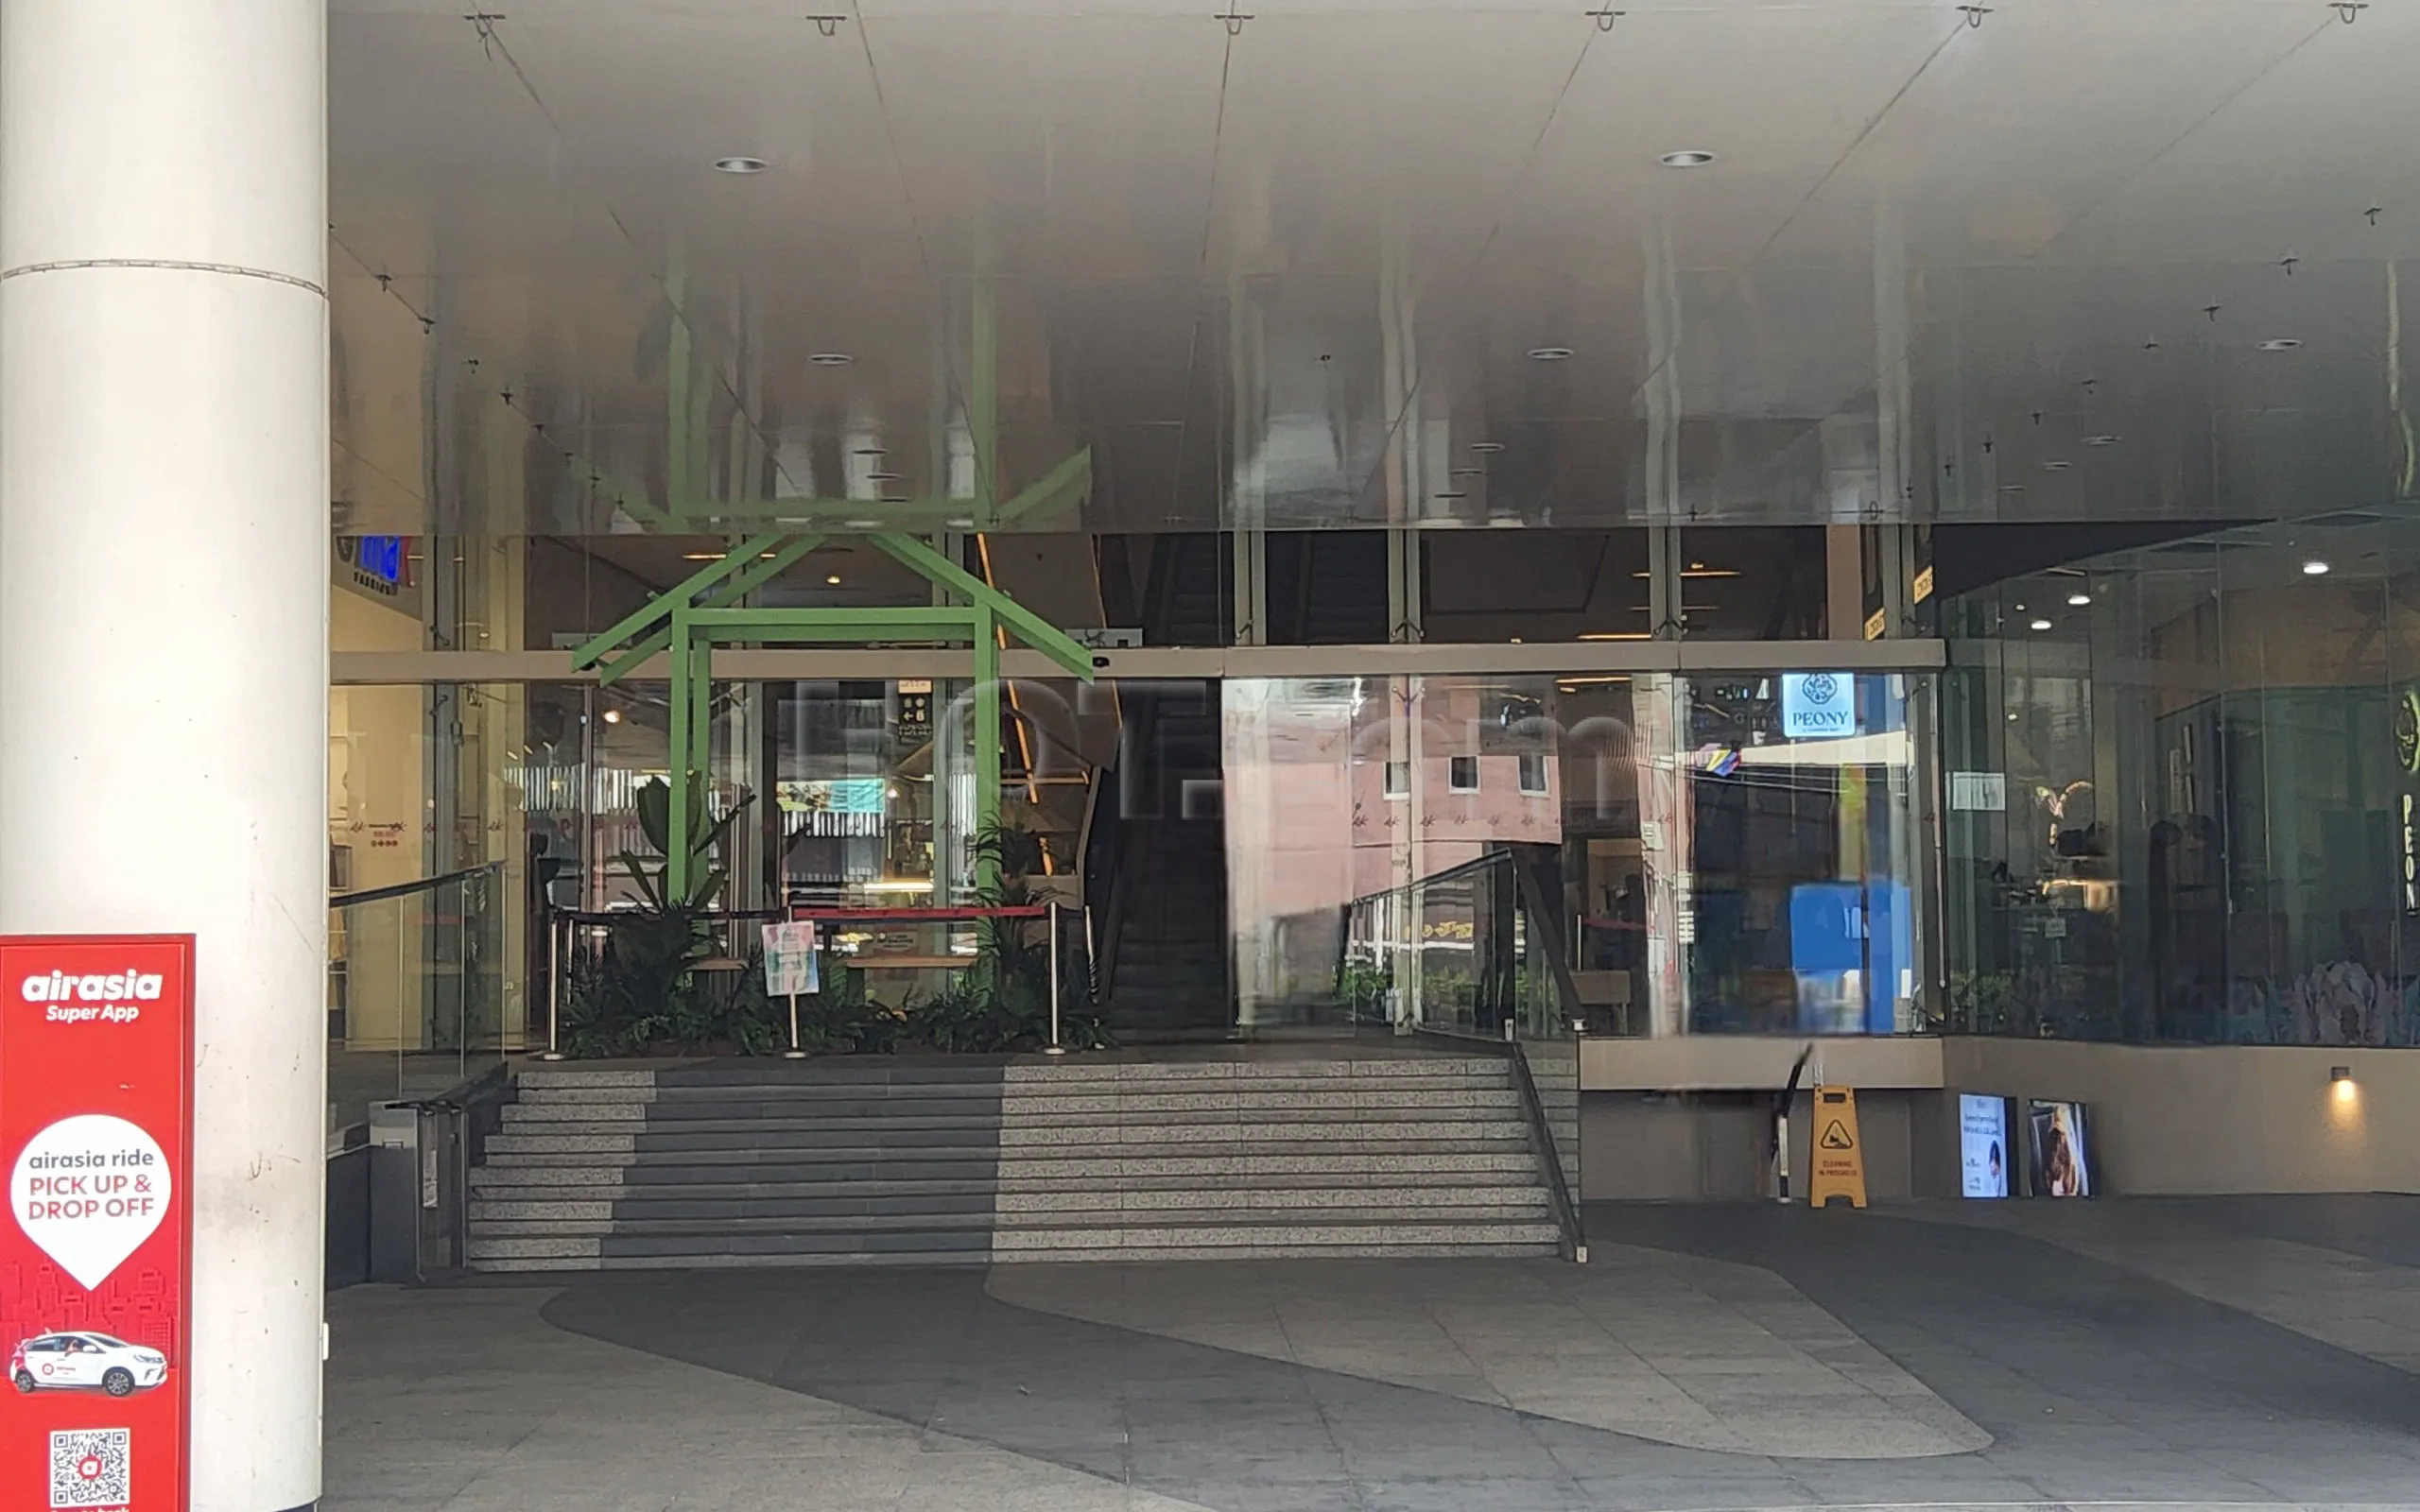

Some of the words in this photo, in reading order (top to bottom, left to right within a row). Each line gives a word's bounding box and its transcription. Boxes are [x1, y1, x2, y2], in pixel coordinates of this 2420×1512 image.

[1792, 711, 1849, 727] PEONY
[22, 969, 164, 1002] airasia
[46, 1005, 99, 1024] Super
[99, 1004, 139, 1022] App
[29, 1150, 106, 1169] airasia
[112, 1148, 154, 1167] ride
[29, 1176, 88, 1196] PICK
[95, 1175, 128, 1194] UP
[134, 1174, 152, 1193] &
[28, 1199, 100, 1221] DROP
[105, 1197, 155, 1217] OFF
